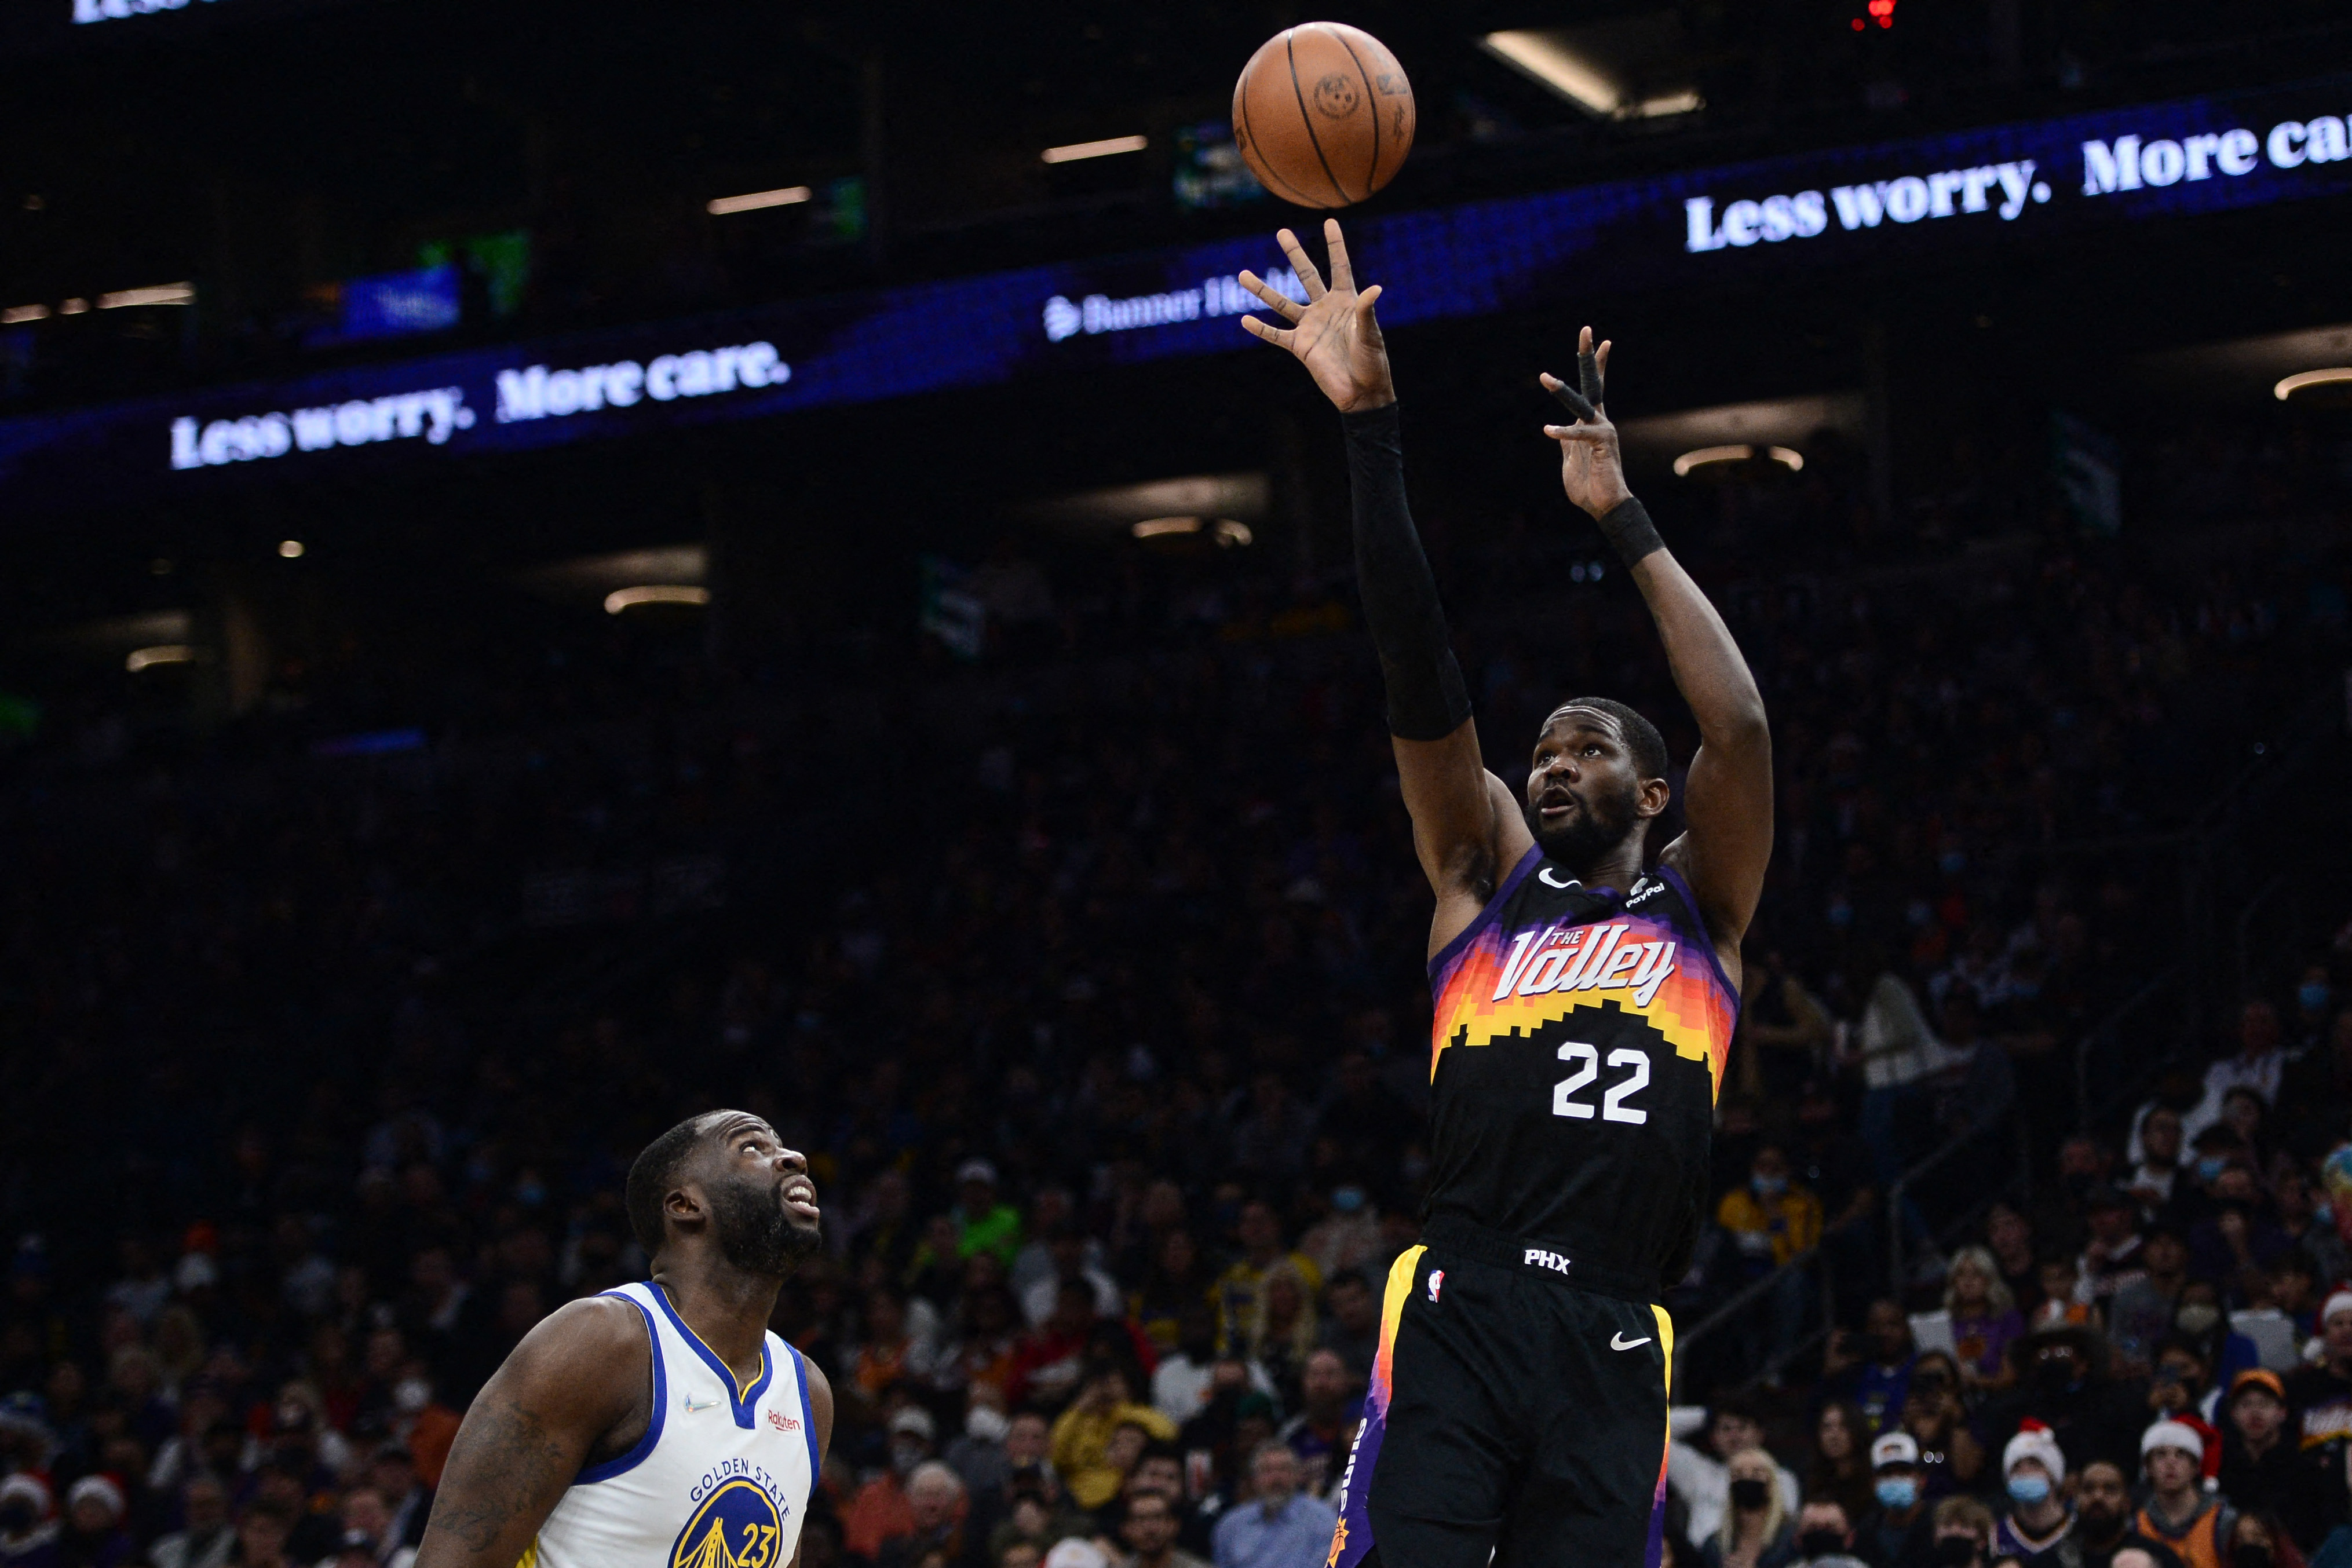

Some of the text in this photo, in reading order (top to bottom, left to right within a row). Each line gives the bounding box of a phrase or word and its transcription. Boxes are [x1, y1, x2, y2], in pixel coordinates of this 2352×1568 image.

[1686, 114, 2352, 253] Less worry. More ca
[171, 341, 791, 470] Less worry. More care.
[1626, 882, 1665, 908] PayPal
[1550, 929, 1584, 946] THE
[1492, 925, 1676, 1007] Valley
[1553, 1041, 1650, 1125] 22
[1524, 1249, 1571, 1275] PHX
[768, 1409, 801, 1430] Rakuten
[690, 1458, 791, 1522] GOLDEN STATE
[737, 1523, 776, 1568] 23
